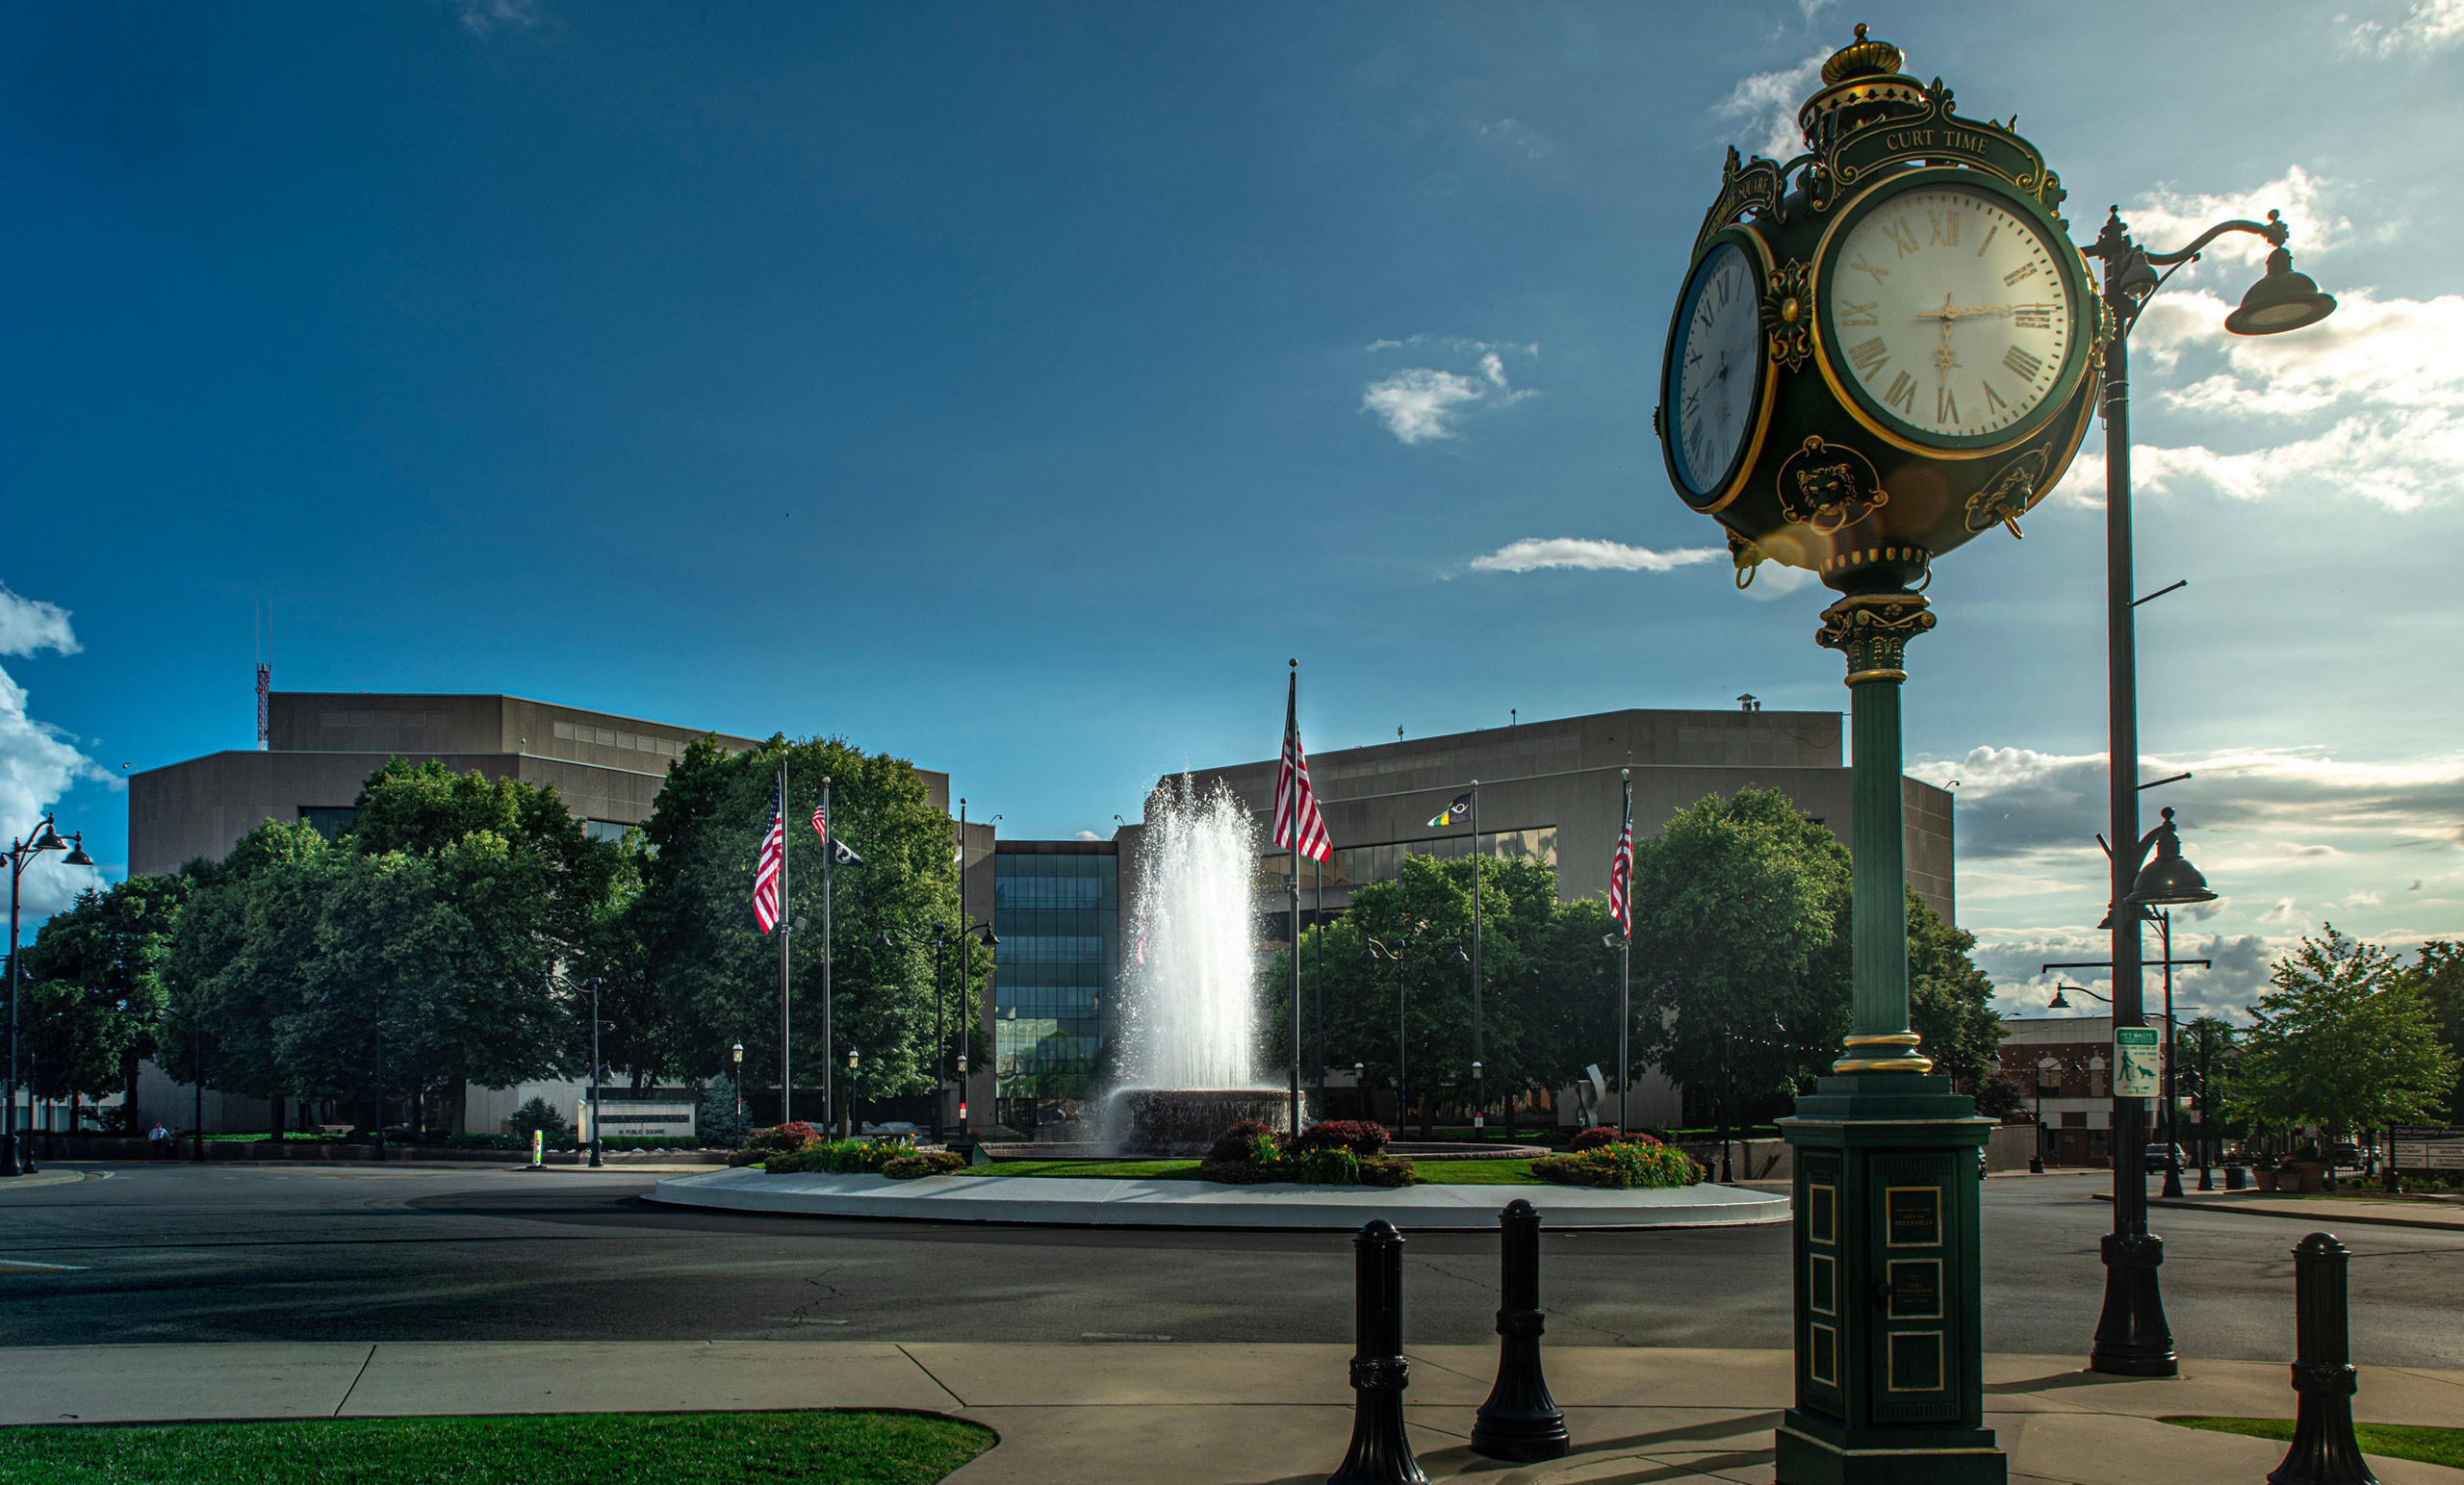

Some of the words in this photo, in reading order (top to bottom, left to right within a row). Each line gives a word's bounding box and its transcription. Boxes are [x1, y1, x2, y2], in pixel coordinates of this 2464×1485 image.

[1886, 129, 1934, 151] CURT
[1942, 131, 1989, 155] TIME
[1882, 217, 1919, 260] XI
[1927, 210, 1960, 246] XII
